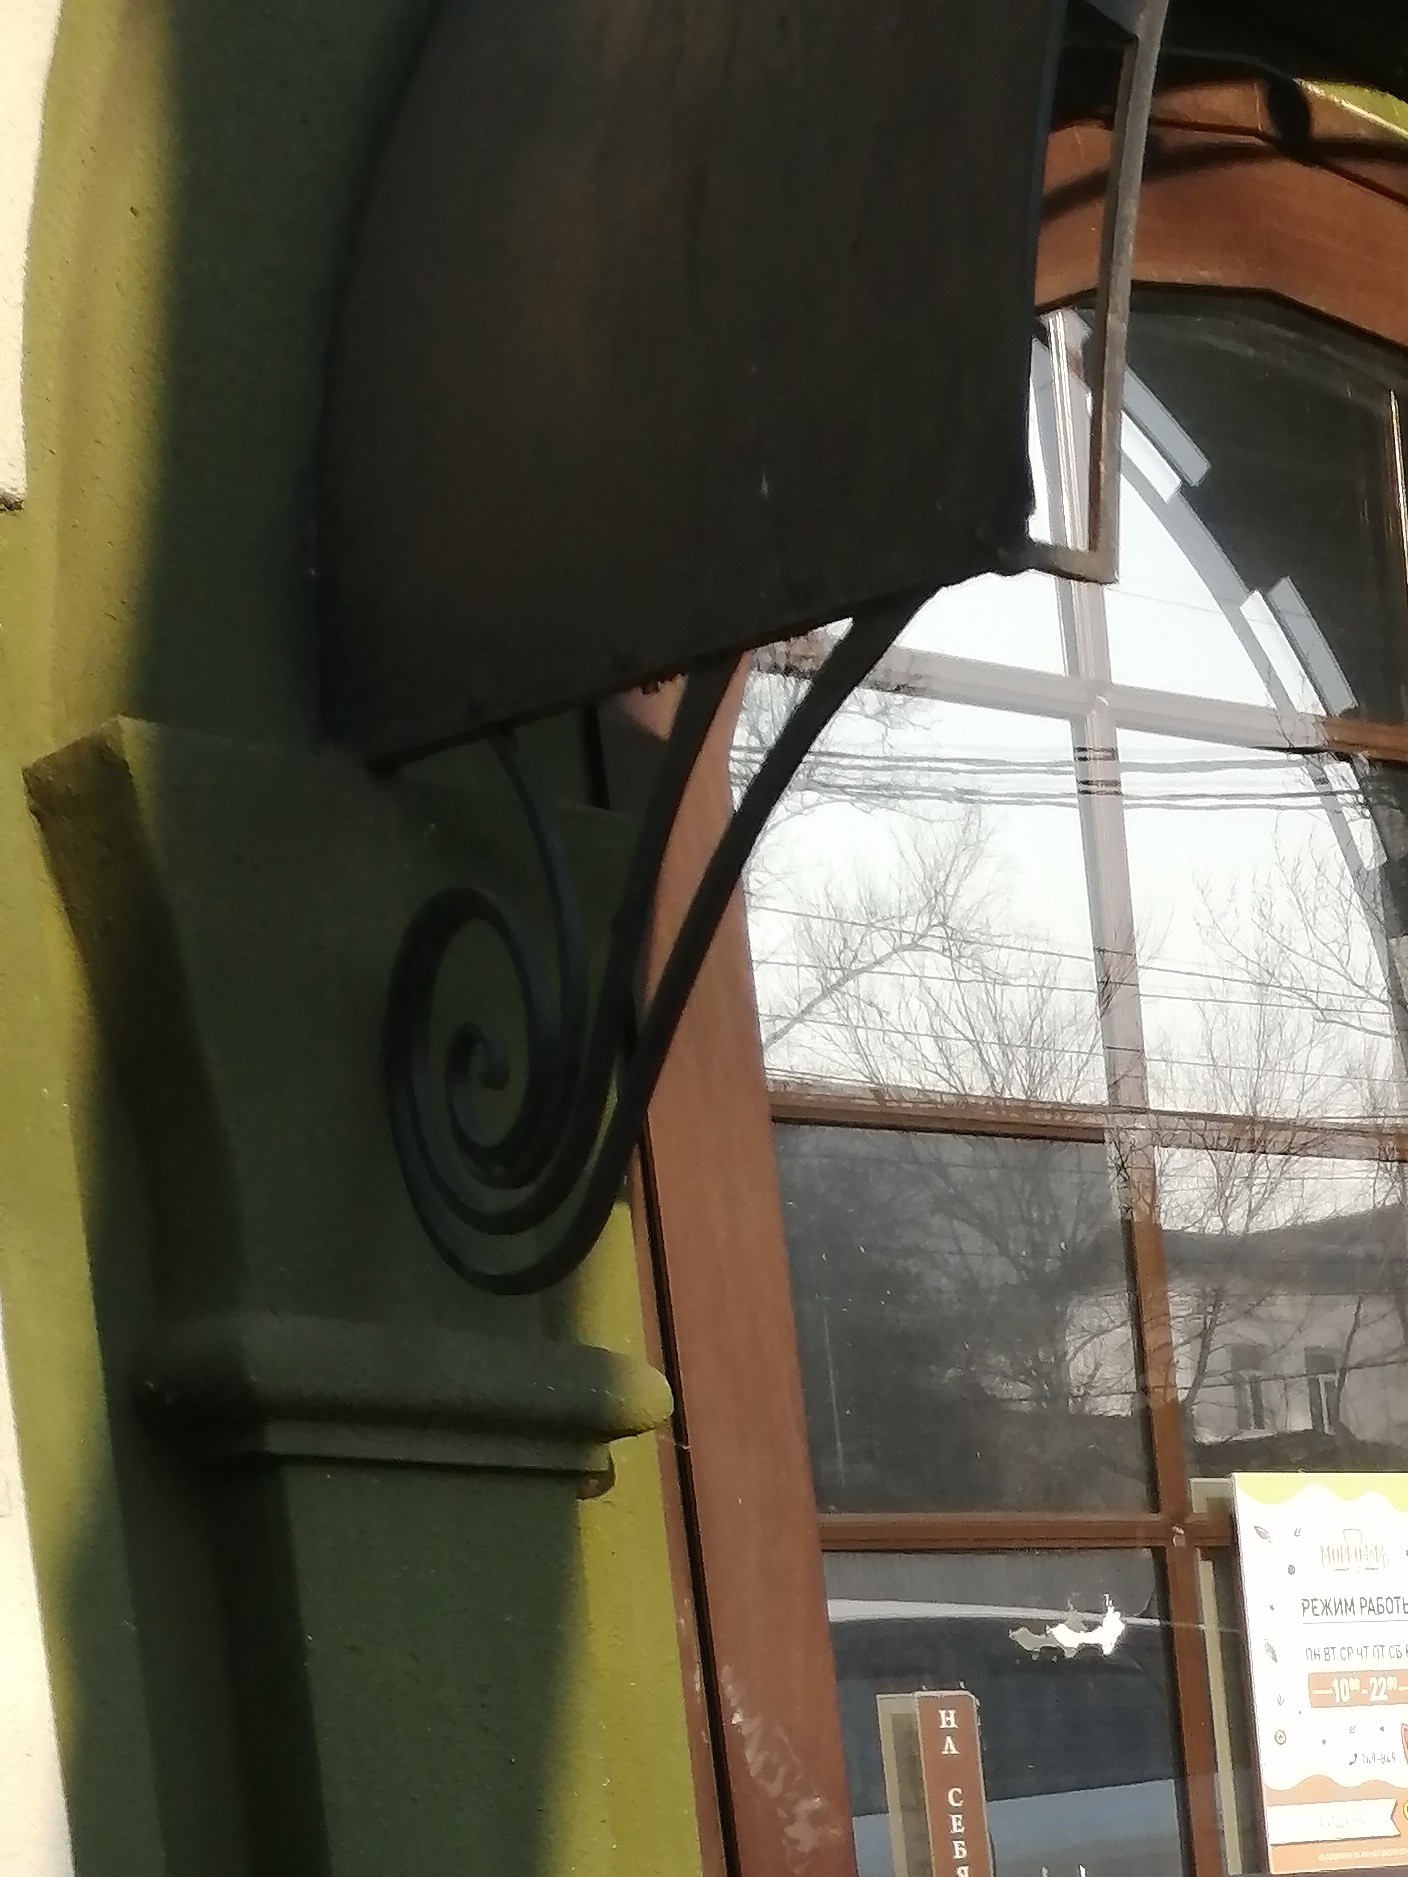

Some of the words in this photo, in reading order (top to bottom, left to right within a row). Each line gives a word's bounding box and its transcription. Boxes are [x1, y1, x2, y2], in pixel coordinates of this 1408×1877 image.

[1301, 1597, 1355, 1617] РЕЖИМ
[1306, 1646, 1321, 1662] ПН
[1323, 1646, 1337, 1662] ВТ
[1340, 1646, 1353, 1661] СР
[1356, 1645, 1369, 1660] ЧТ
[1372, 1644, 1385, 1660] ПТ
[1388, 1644, 1402, 1659] СБ
[938, 1709, 960, 1755] НА
